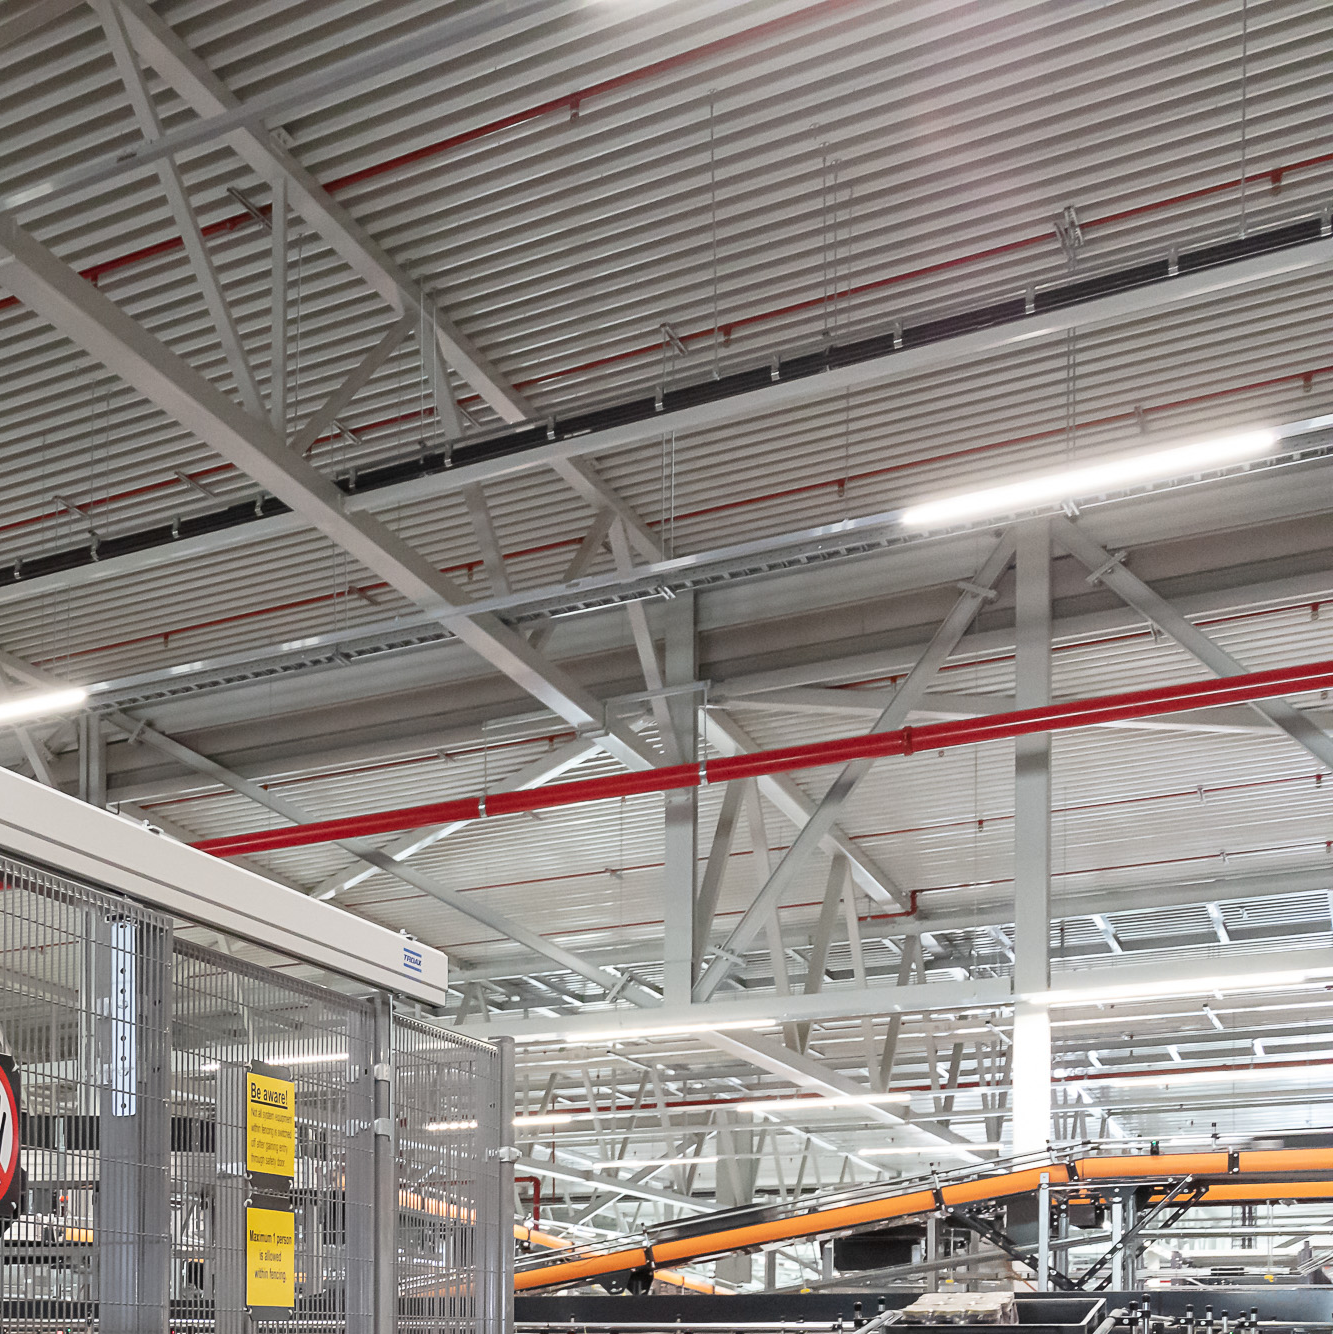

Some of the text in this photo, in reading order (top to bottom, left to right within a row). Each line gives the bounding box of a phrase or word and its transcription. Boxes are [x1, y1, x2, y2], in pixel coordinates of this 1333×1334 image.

[404, 953, 422, 966] TROAX
[251, 1082, 288, 1105] Be aware!
[250, 1230, 272, 1243] Maximum
[277, 1235, 292, 1246] person
[264, 1250, 281, 1262] allowed
[255, 1267, 268, 1279] within
